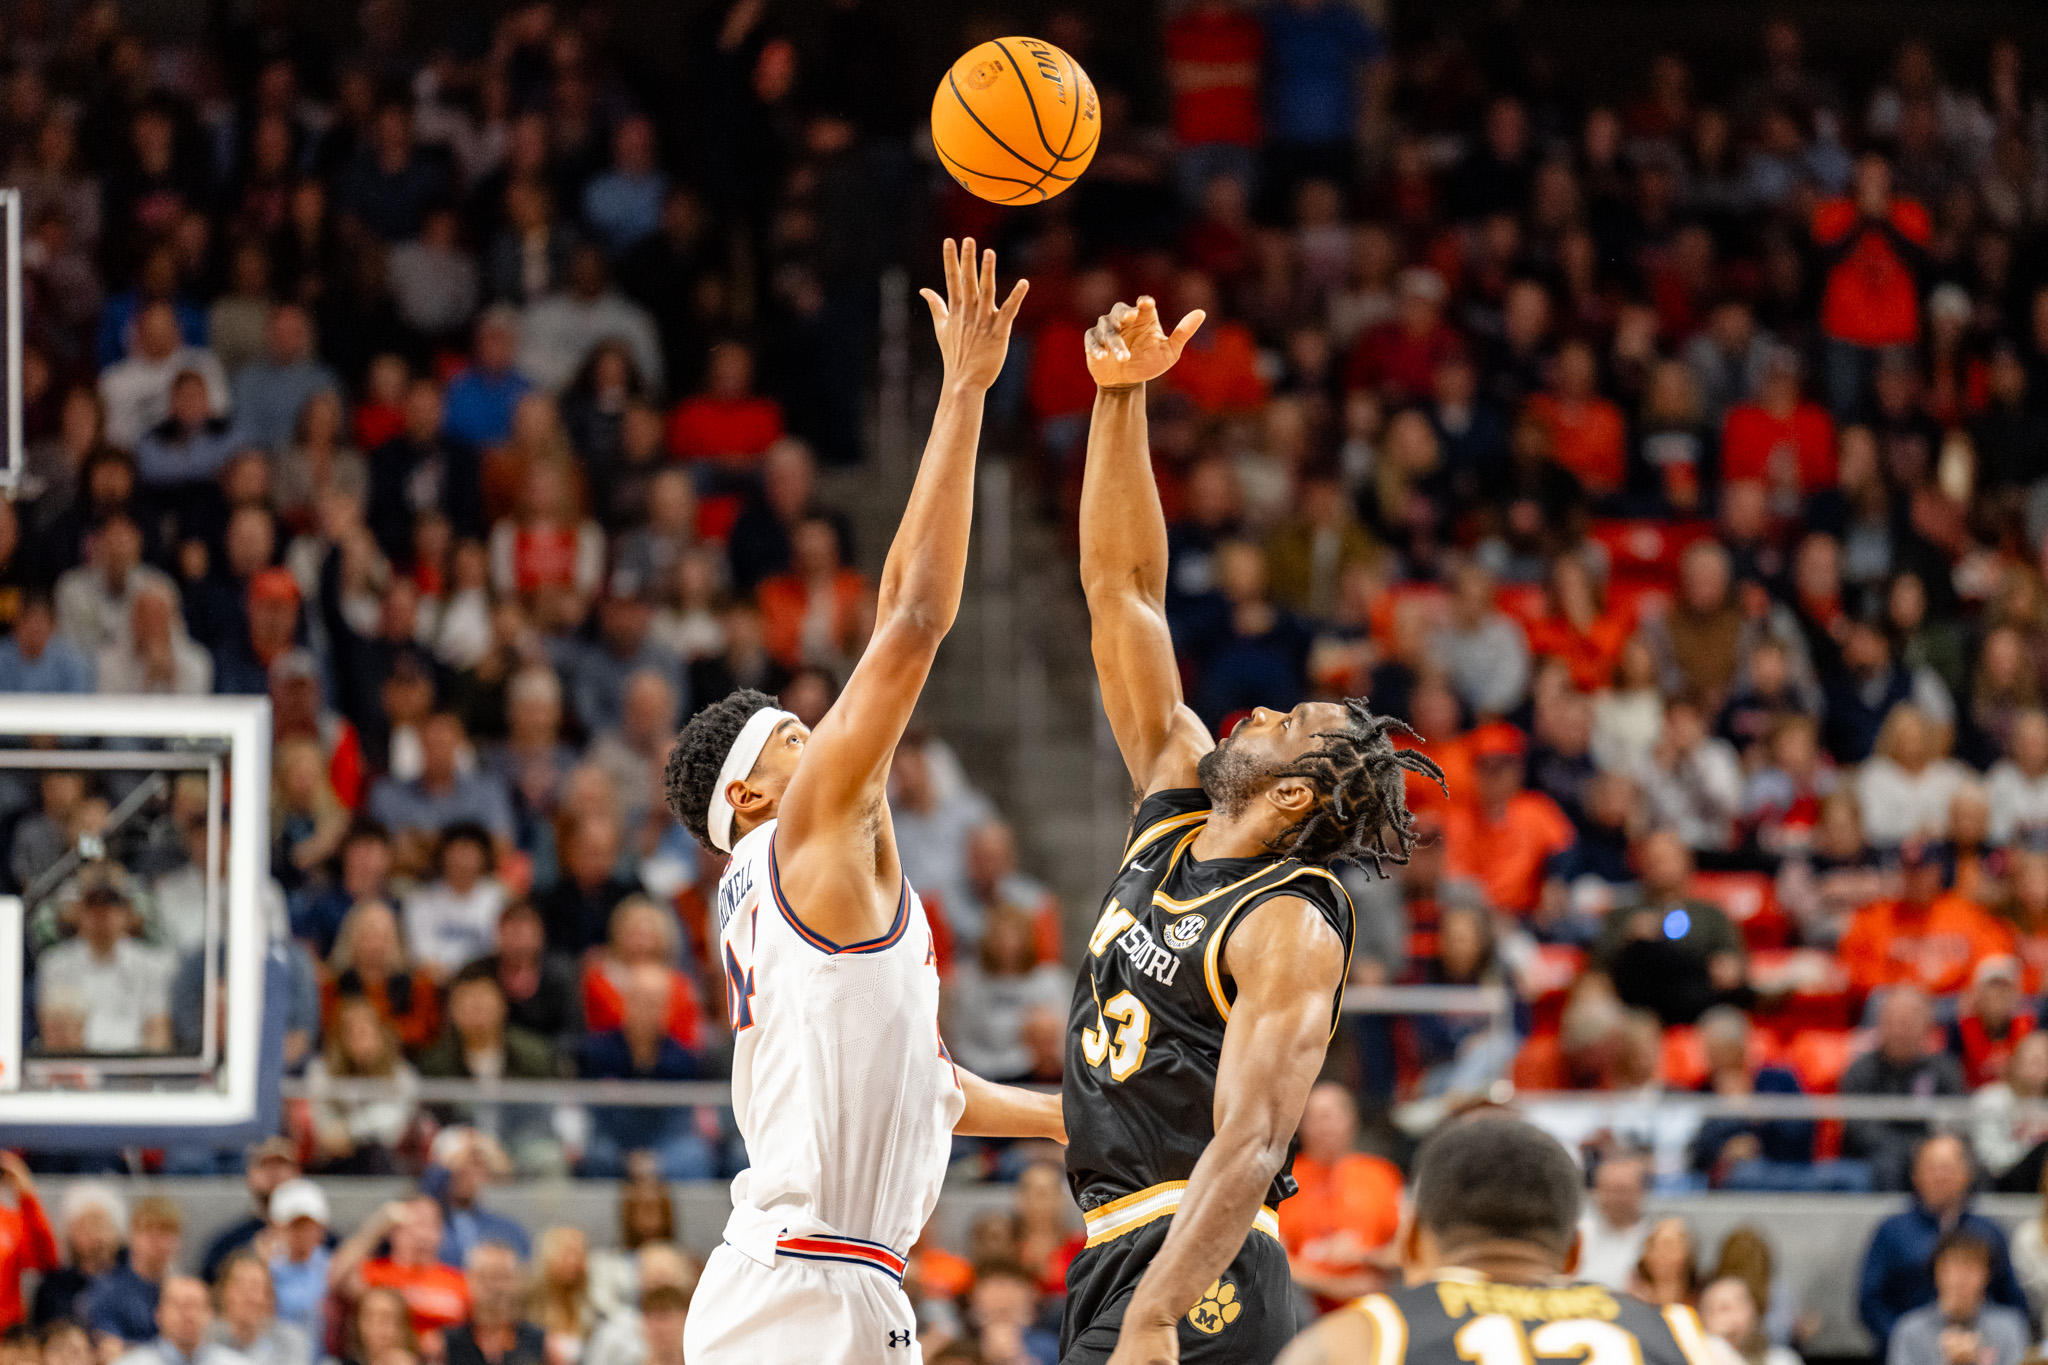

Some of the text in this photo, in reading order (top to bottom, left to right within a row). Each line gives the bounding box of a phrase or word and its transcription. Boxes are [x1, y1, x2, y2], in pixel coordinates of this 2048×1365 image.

[1021, 40, 1063, 84] EVO
[719, 859, 753, 934] RDWELL
[1174, 914, 1206, 940] SEC
[1195, 1307, 1218, 1331] M
